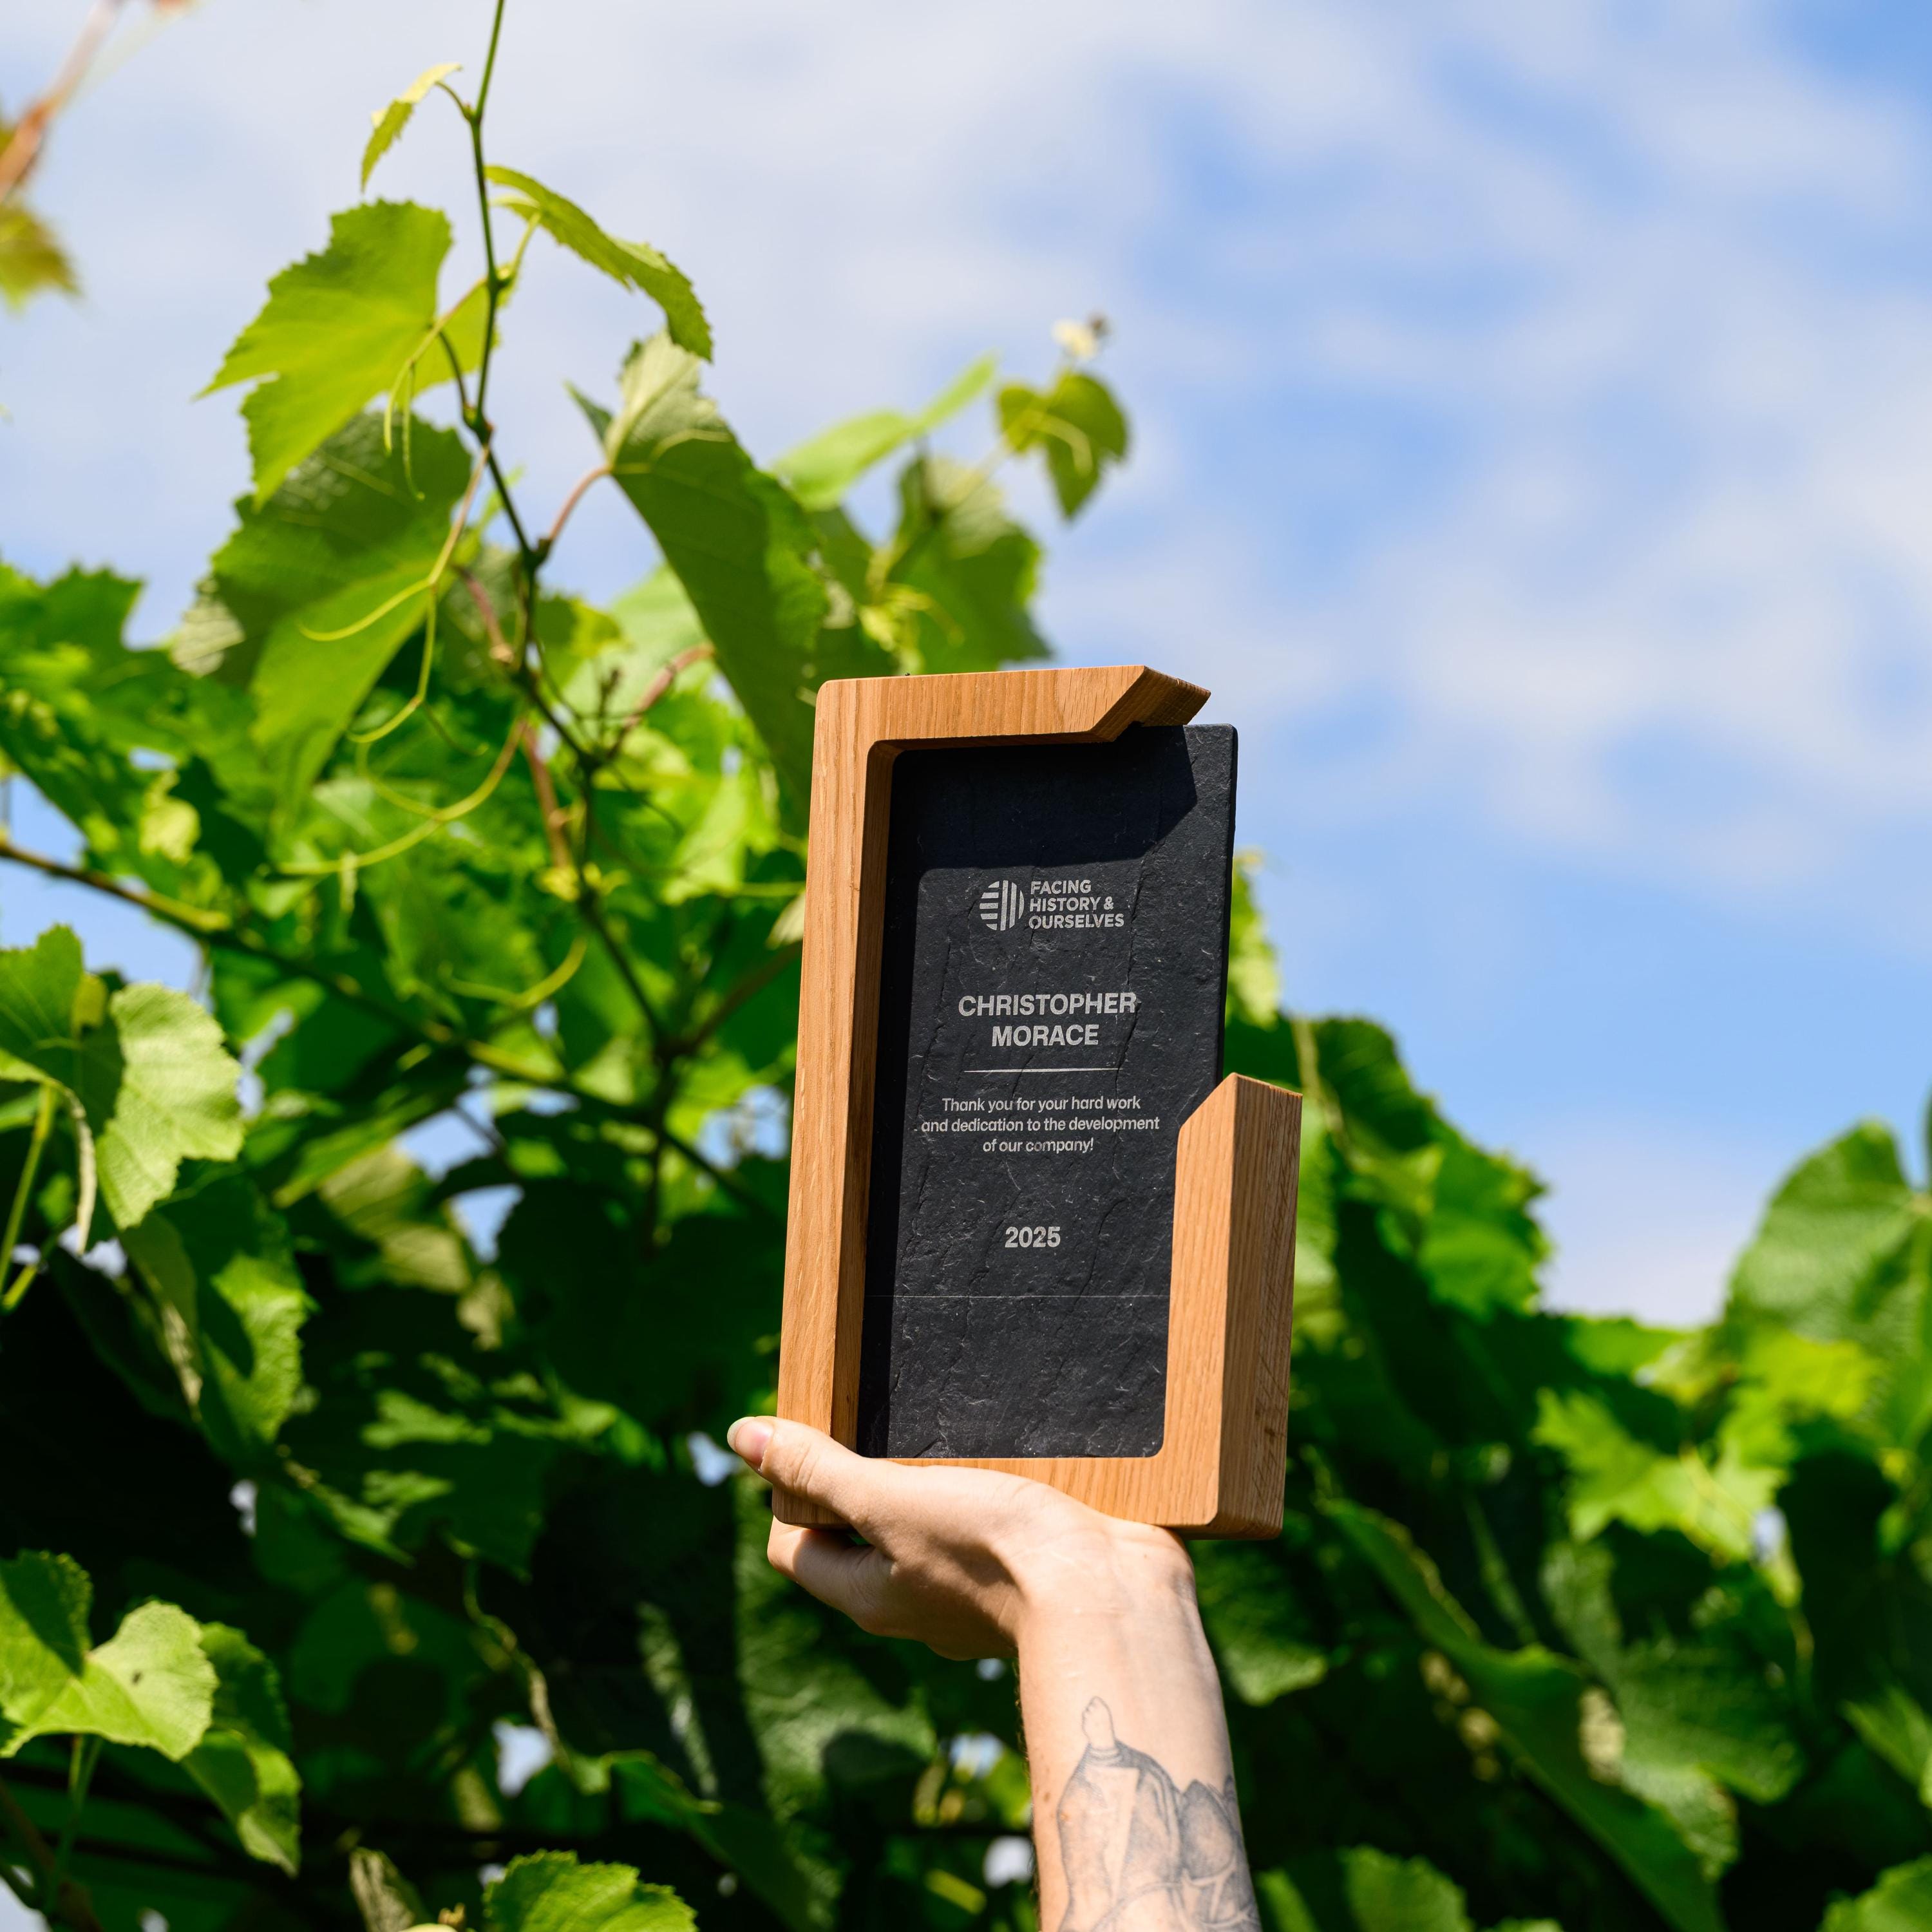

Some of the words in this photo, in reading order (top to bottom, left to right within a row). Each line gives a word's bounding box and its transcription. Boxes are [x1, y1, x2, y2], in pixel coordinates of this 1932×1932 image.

[1030, 879, 1092, 895] FACING
[1030, 896, 1100, 912] HISTORY
[1103, 896, 1114, 910] &
[1028, 913, 1124, 929] OURSELVES
[958, 992, 1137, 1016] CHRISTOPHER
[992, 1024, 1099, 1046] MORACE
[942, 1097, 985, 1112] Thank
[988, 1100, 1012, 1113] you
[1016, 1097, 1036, 1111] for
[1037, 1099, 1068, 1112] your
[1071, 1096, 1103, 1110] hard
[1106, 1095, 1141, 1110] work
[921, 1119, 949, 1132] and
[951, 1118, 1023, 1132] dedication
[1027, 1118, 1041, 1131] to
[1044, 1117, 1066, 1131] the
[1068, 1117, 1160, 1133] development
[983, 1139, 998, 1152] of
[999, 1141, 1023, 1152] our
[1025, 1138, 1094, 1154] company!
[1005, 1226, 1061, 1248] 2025
